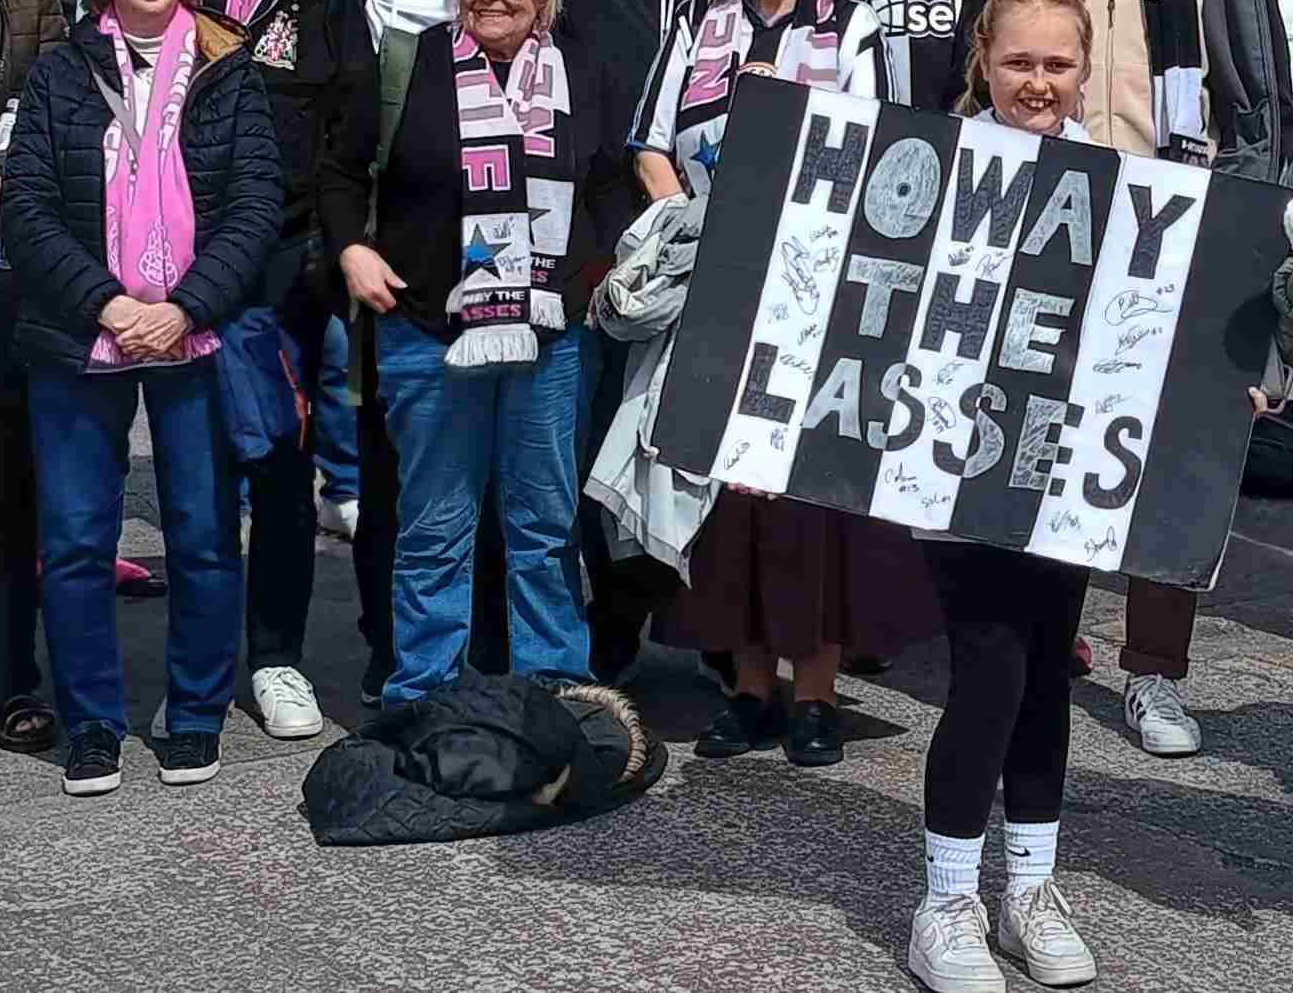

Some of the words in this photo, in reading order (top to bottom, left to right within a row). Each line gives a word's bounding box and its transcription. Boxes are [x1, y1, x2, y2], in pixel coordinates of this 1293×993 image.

[791, 113, 1197, 281] HOWAY
[460, 304, 522, 322] ASSES
[495, 290, 525, 301] THE
[846, 252, 1077, 376] THE
[736, 341, 1143, 510] LASSES
